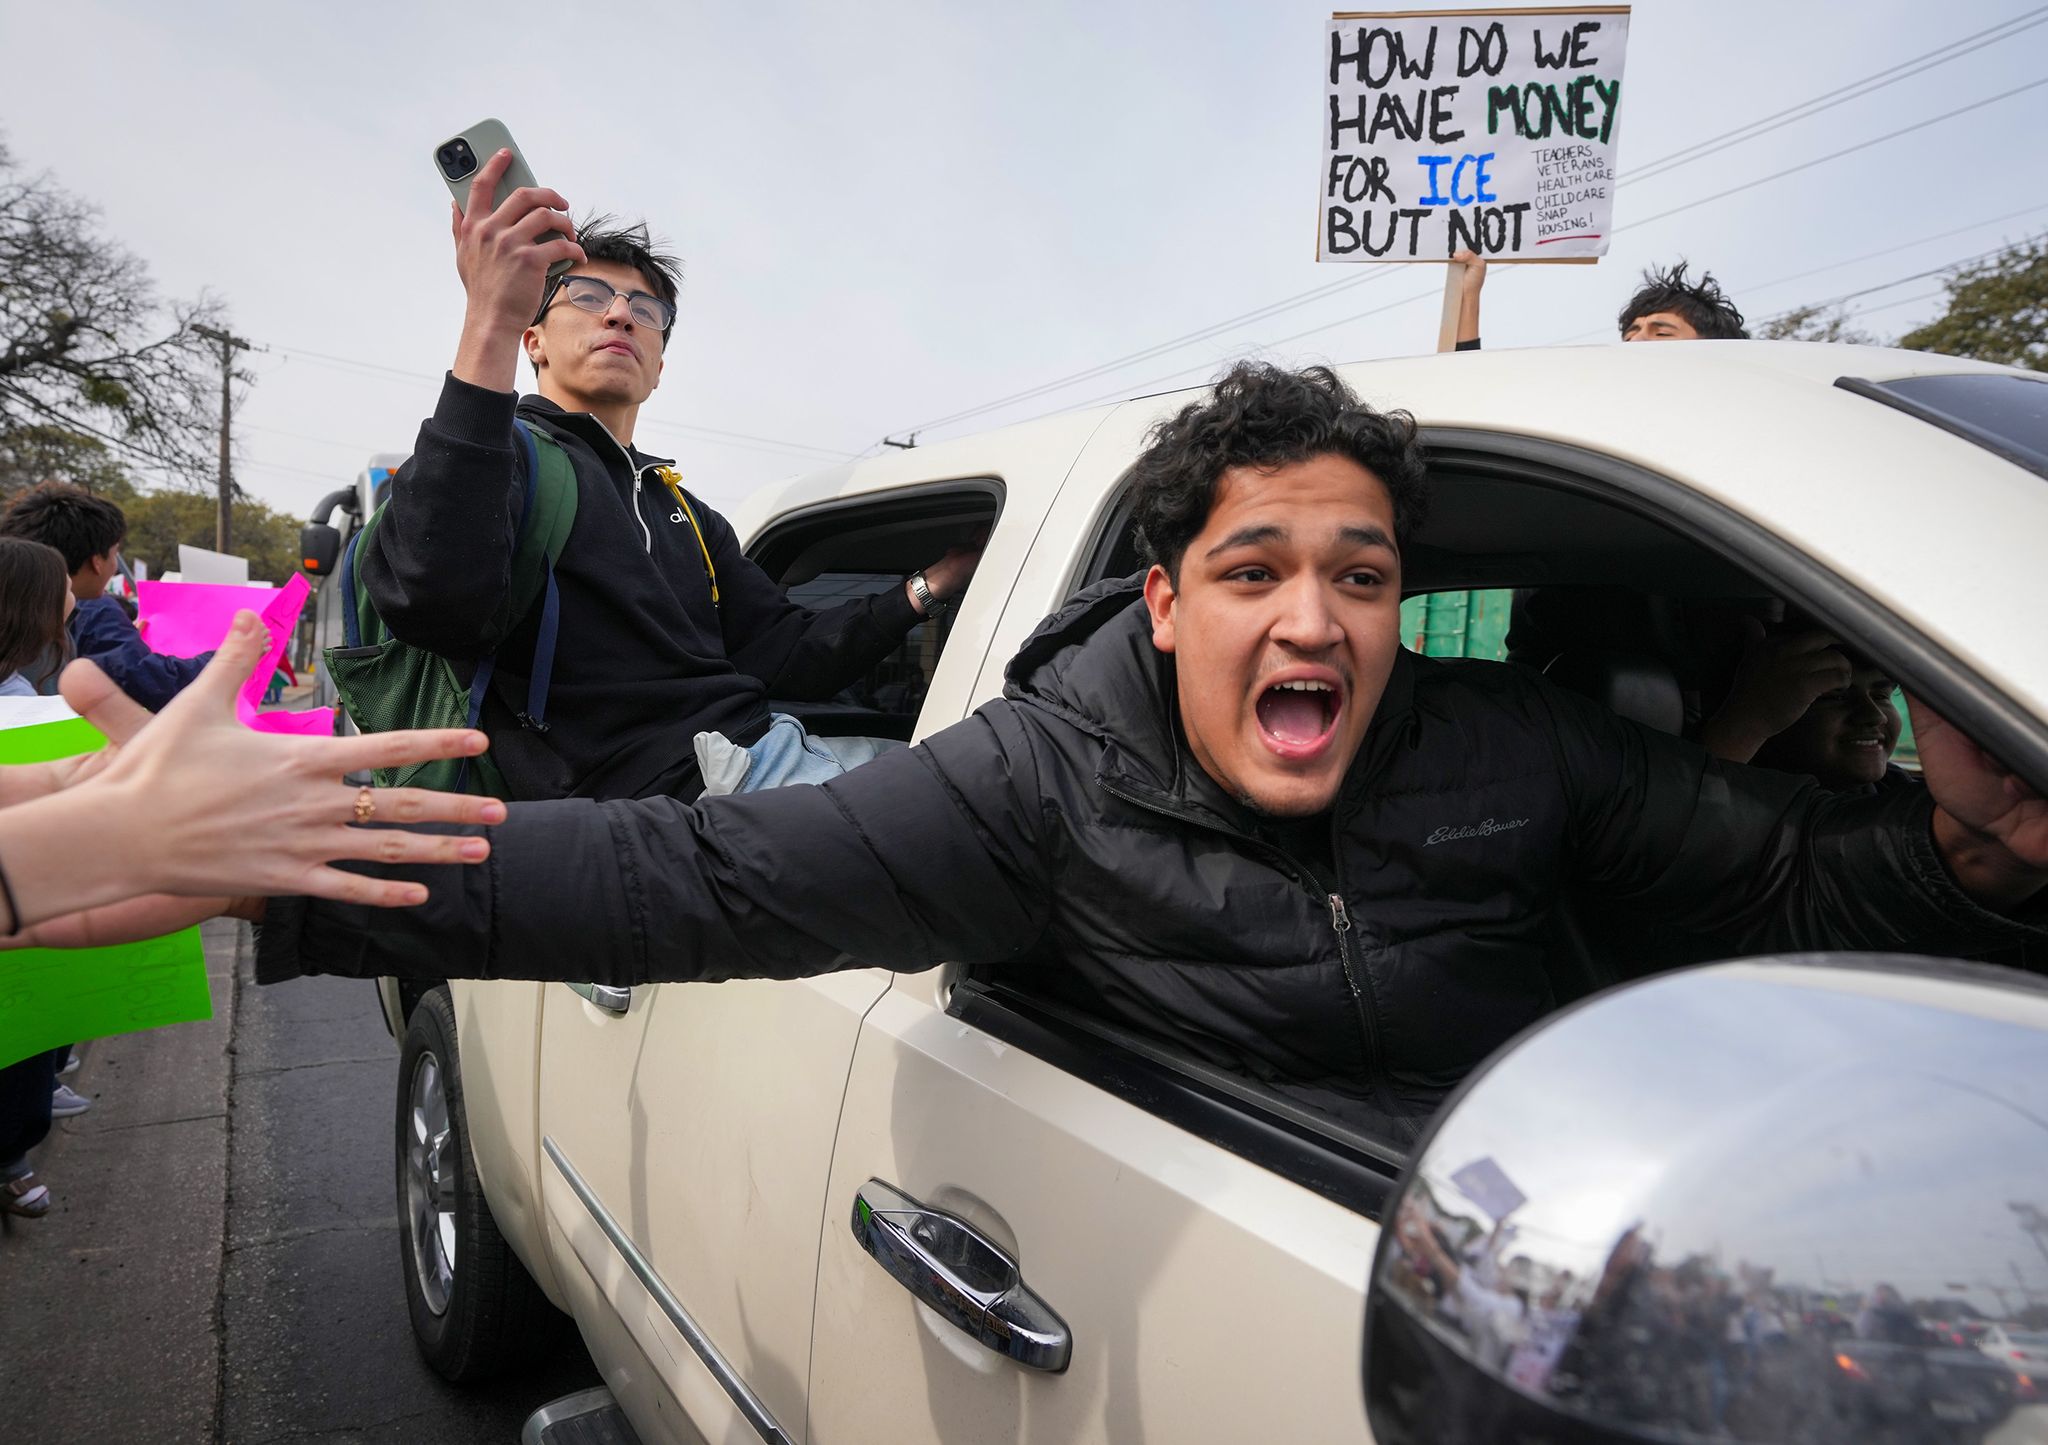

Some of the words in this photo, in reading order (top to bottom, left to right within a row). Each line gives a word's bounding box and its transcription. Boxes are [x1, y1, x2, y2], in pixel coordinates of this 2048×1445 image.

[1330, 26, 1438, 89] HOW
[1457, 22, 1508, 78] DO
[1534, 22, 1601, 70] WE
[1329, 86, 1465, 150] HAVE
[1487, 75, 1620, 144] MONEY
[1531, 145, 1593, 164] TEACHERS
[1328, 155, 1396, 204] FOR
[1418, 152, 1497, 206] ICE
[1537, 157, 1605, 177] VETERANS
[1537, 175, 1582, 193] HEALTH
[1585, 169, 1614, 182] CARE
[1535, 187, 1606, 211] CHILDCARE
[1536, 207, 1568, 222] SNAP
[1328, 206, 1432, 257] BUT
[1448, 202, 1531, 258] NOT
